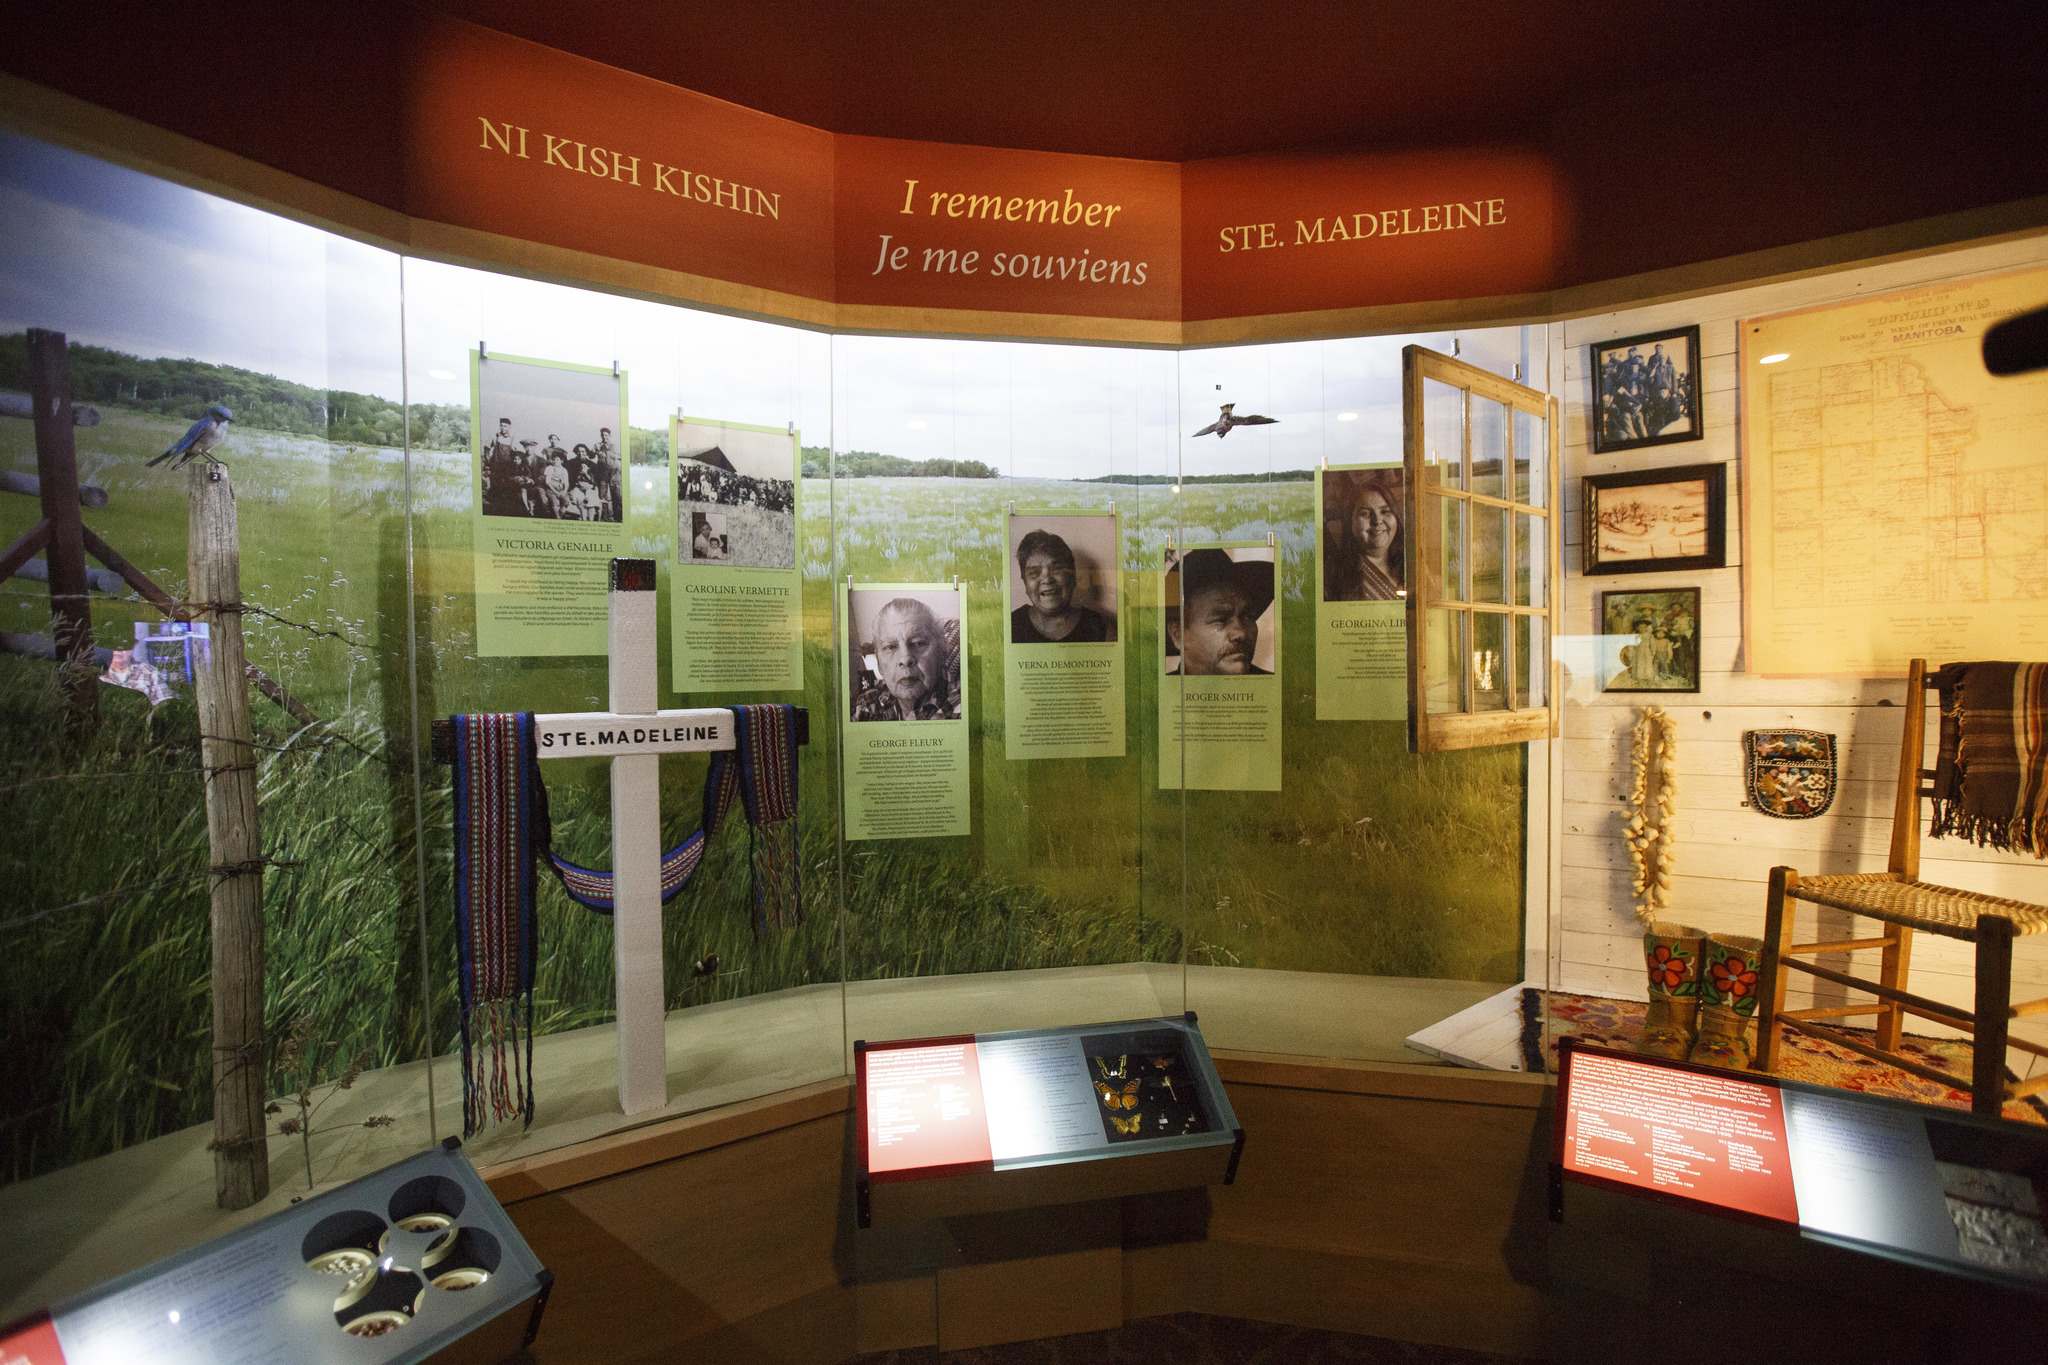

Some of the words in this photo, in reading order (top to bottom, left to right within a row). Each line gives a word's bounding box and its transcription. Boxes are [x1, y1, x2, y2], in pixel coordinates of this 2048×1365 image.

[478, 116, 531, 159] NI
[542, 133, 641, 186] KISH
[652, 162, 781, 220] KISHIN
[900, 179, 919, 215] I
[929, 188, 1122, 228] remember
[1219, 223, 1285, 252] STE.
[1294, 198, 1507, 245] MADELEINE
[872, 234, 909, 276] Je
[922, 247, 980, 274] me
[990, 248, 1149, 286] souviens
[1892, 324, 1965, 343] MANITOBA
[496, 538, 554, 551] VICTORIA
[557, 541, 614, 553] GENAILLE
[685, 584, 736, 595] CAROLINE
[739, 586, 790, 596] VERMETTE
[1330, 619, 1387, 629] GEORGINA
[1018, 661, 1049, 670] VERNA
[1051, 660, 1113, 669] DEMONTIGNY
[1185, 693, 1219, 701] ROGER
[1222, 693, 1254, 701] SMITH
[868, 739, 907, 749] GEORGE
[909, 738, 944, 747] FLEURY
